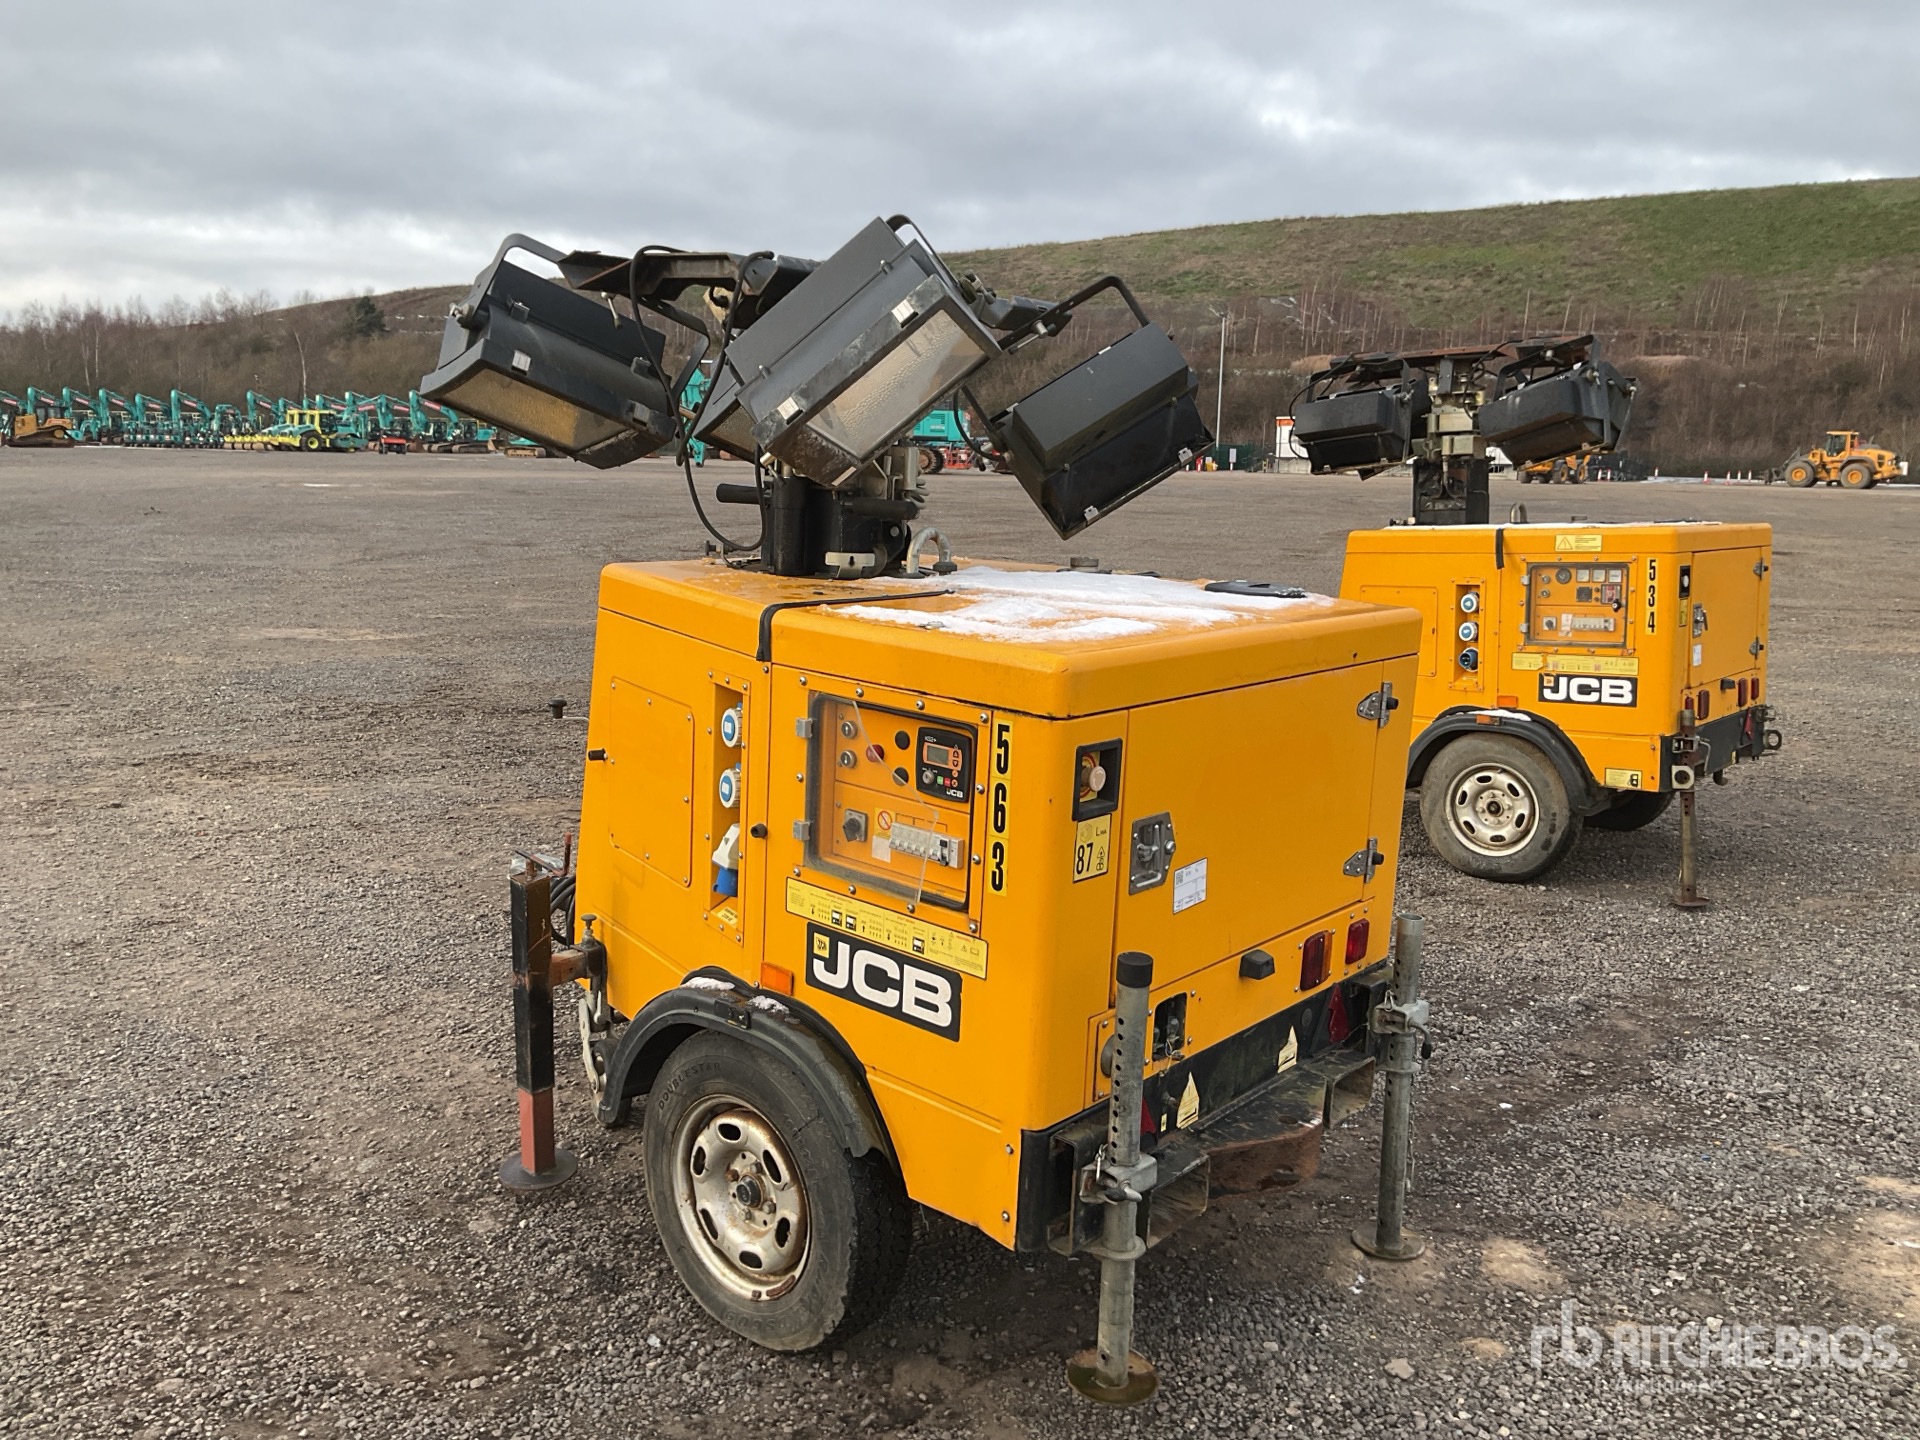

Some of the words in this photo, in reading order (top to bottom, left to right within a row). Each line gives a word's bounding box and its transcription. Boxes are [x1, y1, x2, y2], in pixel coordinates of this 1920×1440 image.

[1648, 559, 1657, 633] 534
[1543, 676, 1633, 704] JCB
[946, 788, 964, 799] JCB
[991, 723, 1010, 892] 563
[1076, 842, 1094, 875] 87
[812, 941, 953, 1028] JCB
[658, 1061, 721, 1110] DOUBLESTAR
